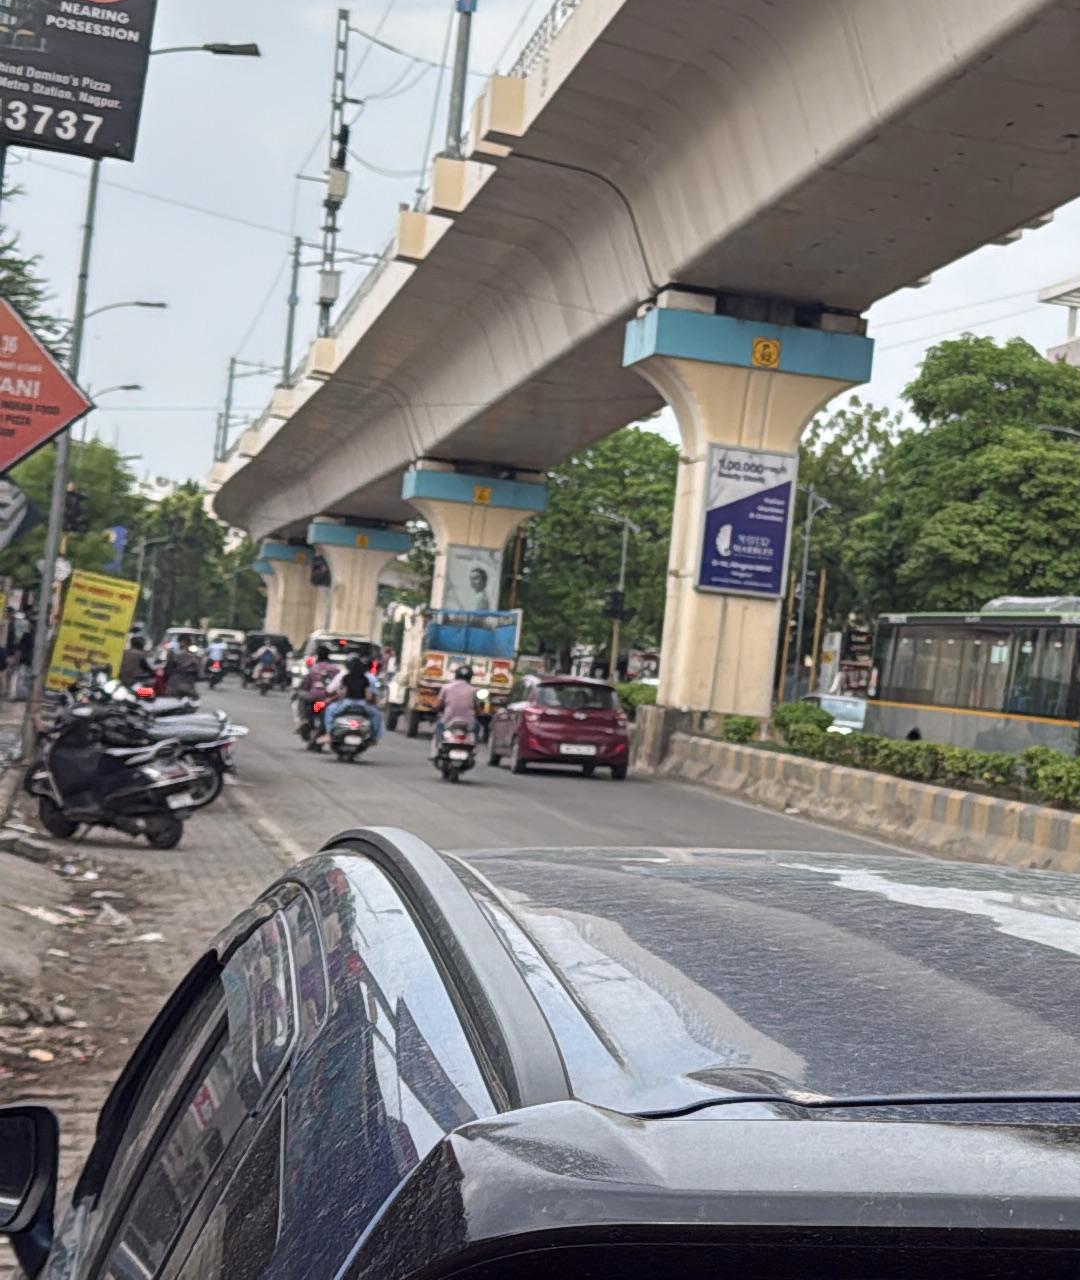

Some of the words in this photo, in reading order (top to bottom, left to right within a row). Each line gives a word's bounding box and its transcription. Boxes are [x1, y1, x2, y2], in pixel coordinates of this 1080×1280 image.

[60, 1, 130, 24] NEARING
[45, 14, 140, 42] POSSESSION
[26, 65, 79, 87] Domino's
[81, 77, 111, 93] Pizza
[32, 82, 76, 102] Station,
[0, 98, 104, 145] 3737
